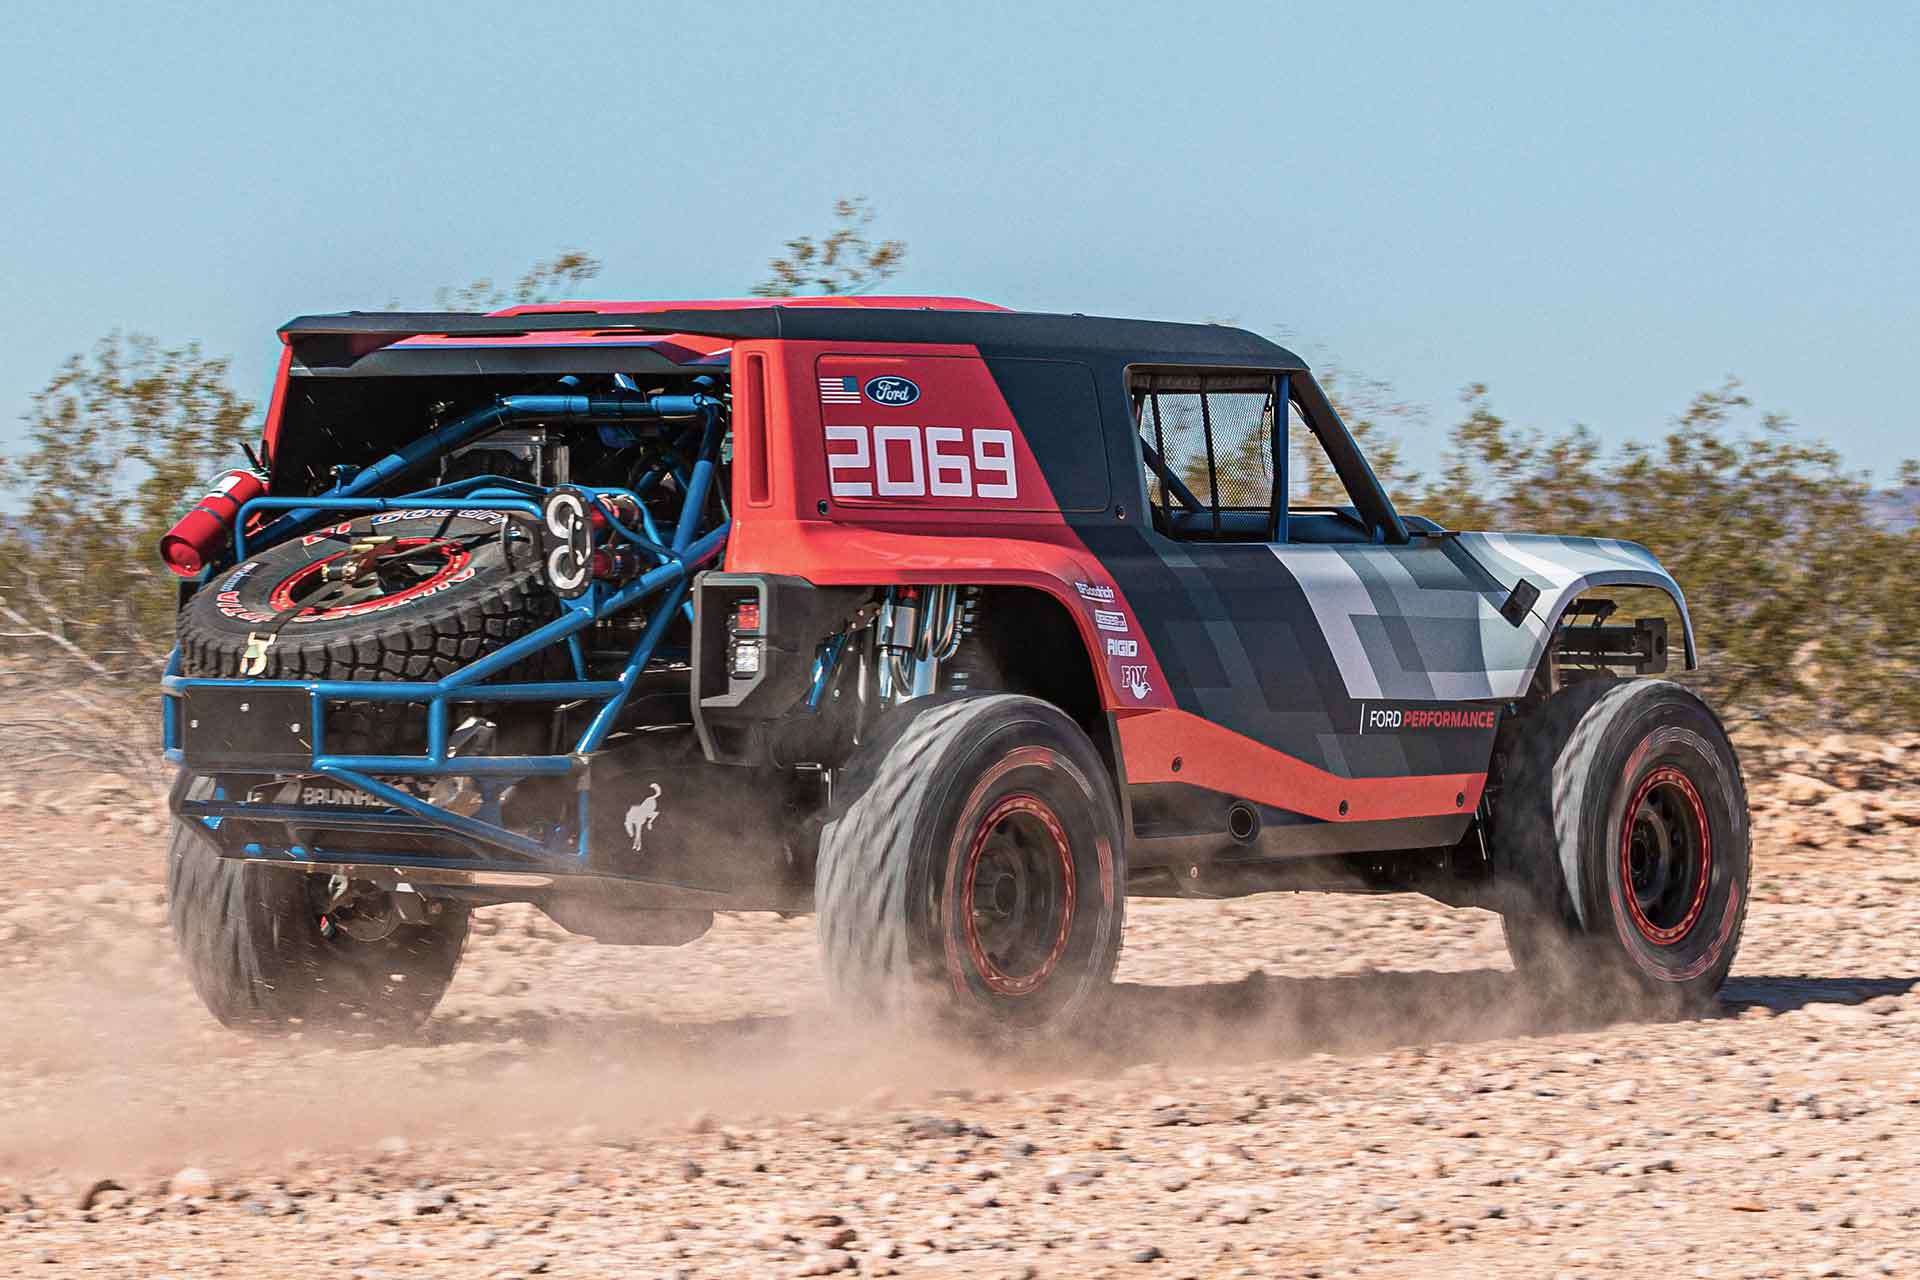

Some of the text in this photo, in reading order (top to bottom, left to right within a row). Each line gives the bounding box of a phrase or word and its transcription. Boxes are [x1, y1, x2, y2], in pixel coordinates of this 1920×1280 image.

[876, 380, 910, 401] Ford
[825, 425, 1018, 499] 2069
[1121, 665, 1148, 689] FOX
[1369, 709, 1495, 729] FORD PERFORMANCE
